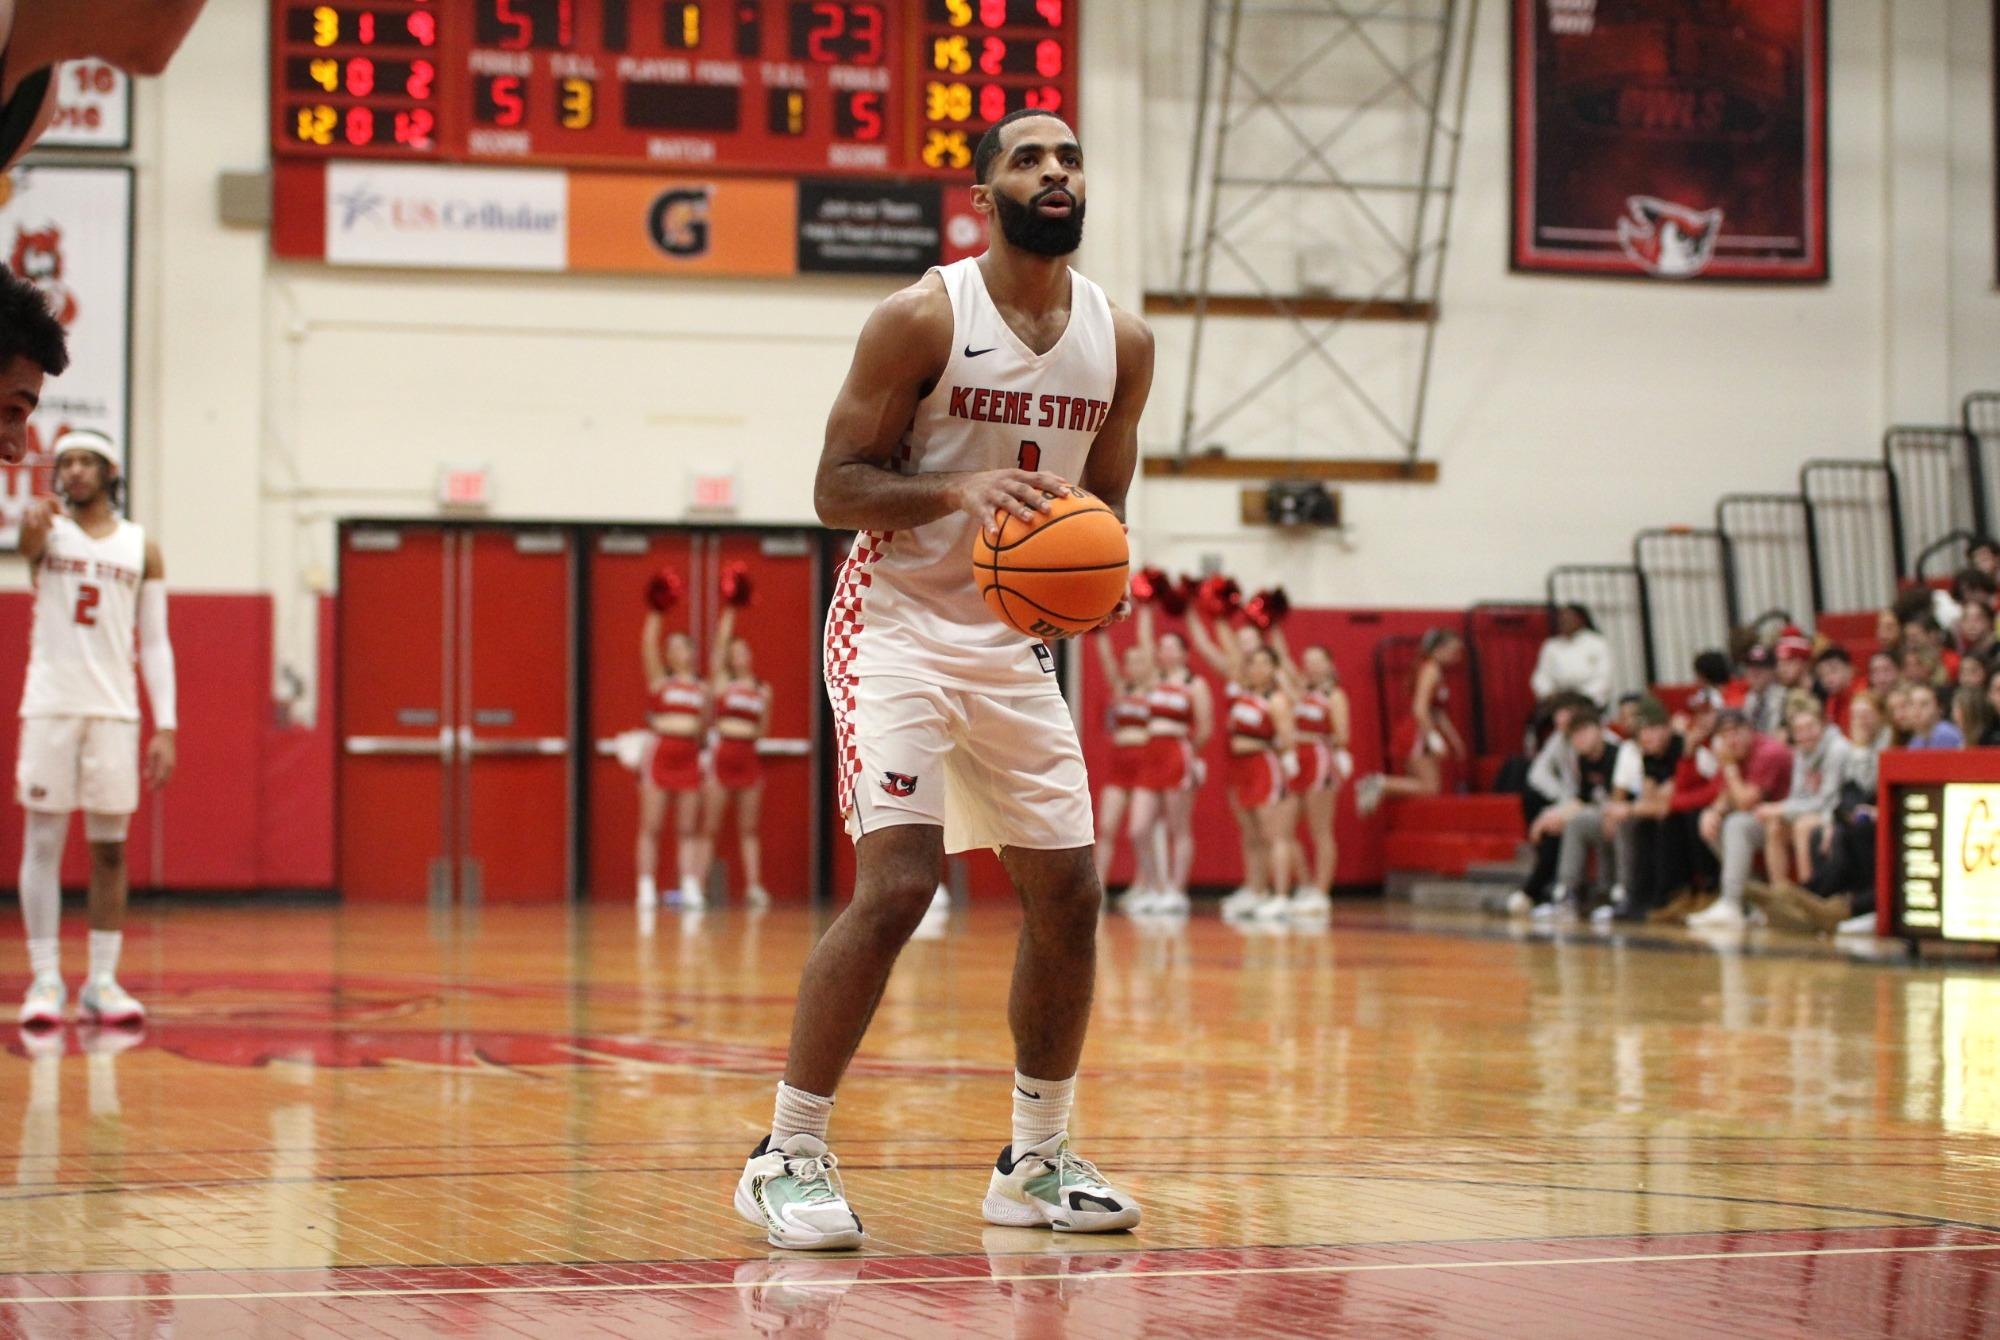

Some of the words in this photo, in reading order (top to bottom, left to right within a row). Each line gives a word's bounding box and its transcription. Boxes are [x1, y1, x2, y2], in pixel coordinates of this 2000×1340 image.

[313, 6, 339, 47] 3
[359, 11, 375, 45] 1
[808, 3, 883, 63] 23
[979, 36, 1006, 75] 2
[407, 60, 434, 99] 2
[490, 75, 524, 126] 5
[562, 77, 592, 129] 3
[851, 91, 881, 139] 5
[949, 386, 1033, 426] KEENE
[1038, 394, 1107, 432] STATE
[74, 583, 100, 627] 2
